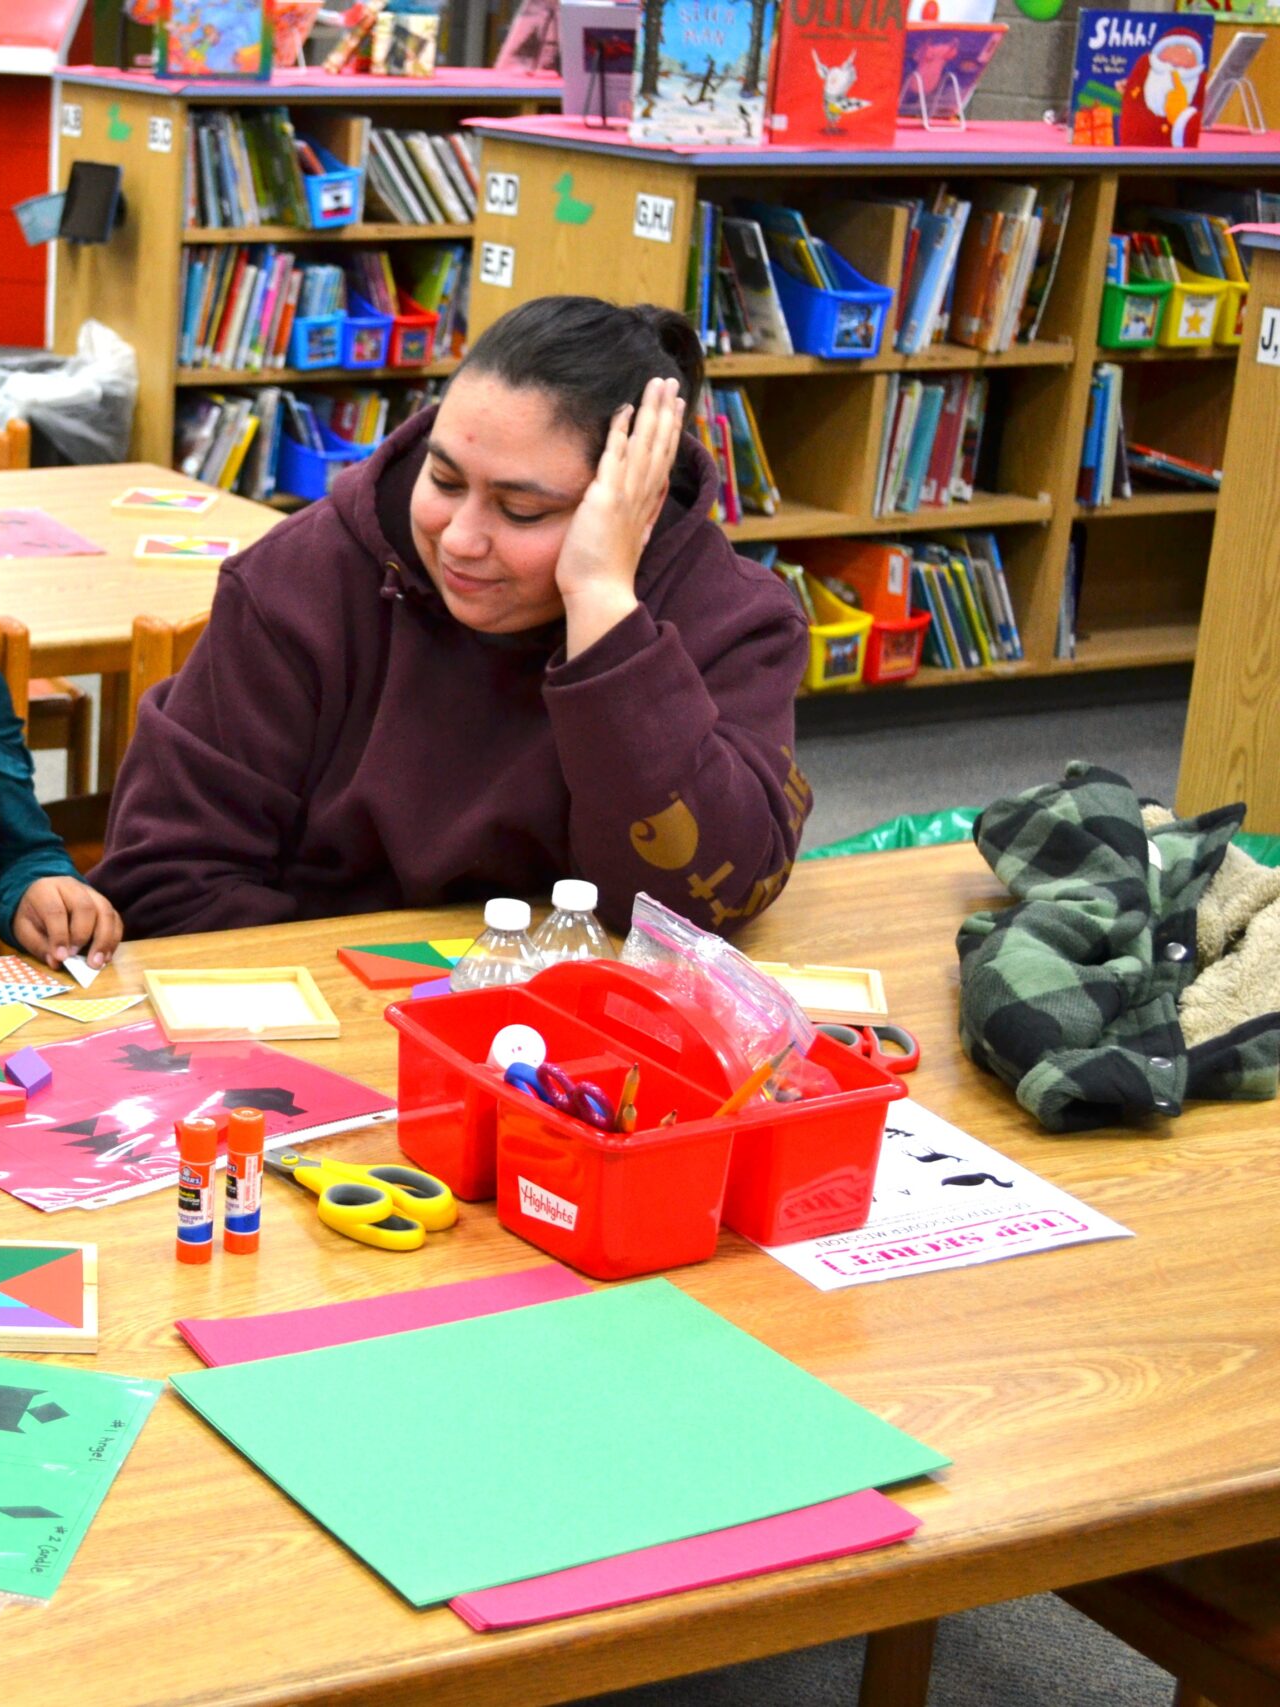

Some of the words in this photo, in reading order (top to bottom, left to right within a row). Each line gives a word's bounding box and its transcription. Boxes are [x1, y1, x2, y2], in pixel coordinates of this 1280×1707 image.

[791, 0, 904, 31] OLIVIA
[1088, 17, 1157, 50] Shhh!
[521, 1184, 574, 1225] Highlights
[815, 1230, 889, 1249] MISSION
[995, 1217, 1064, 1238] TOP
[850, 1233, 985, 1267] SECRET
[88, 1436, 116, 1463] Angel
[29, 1544, 59, 1574] Candle
